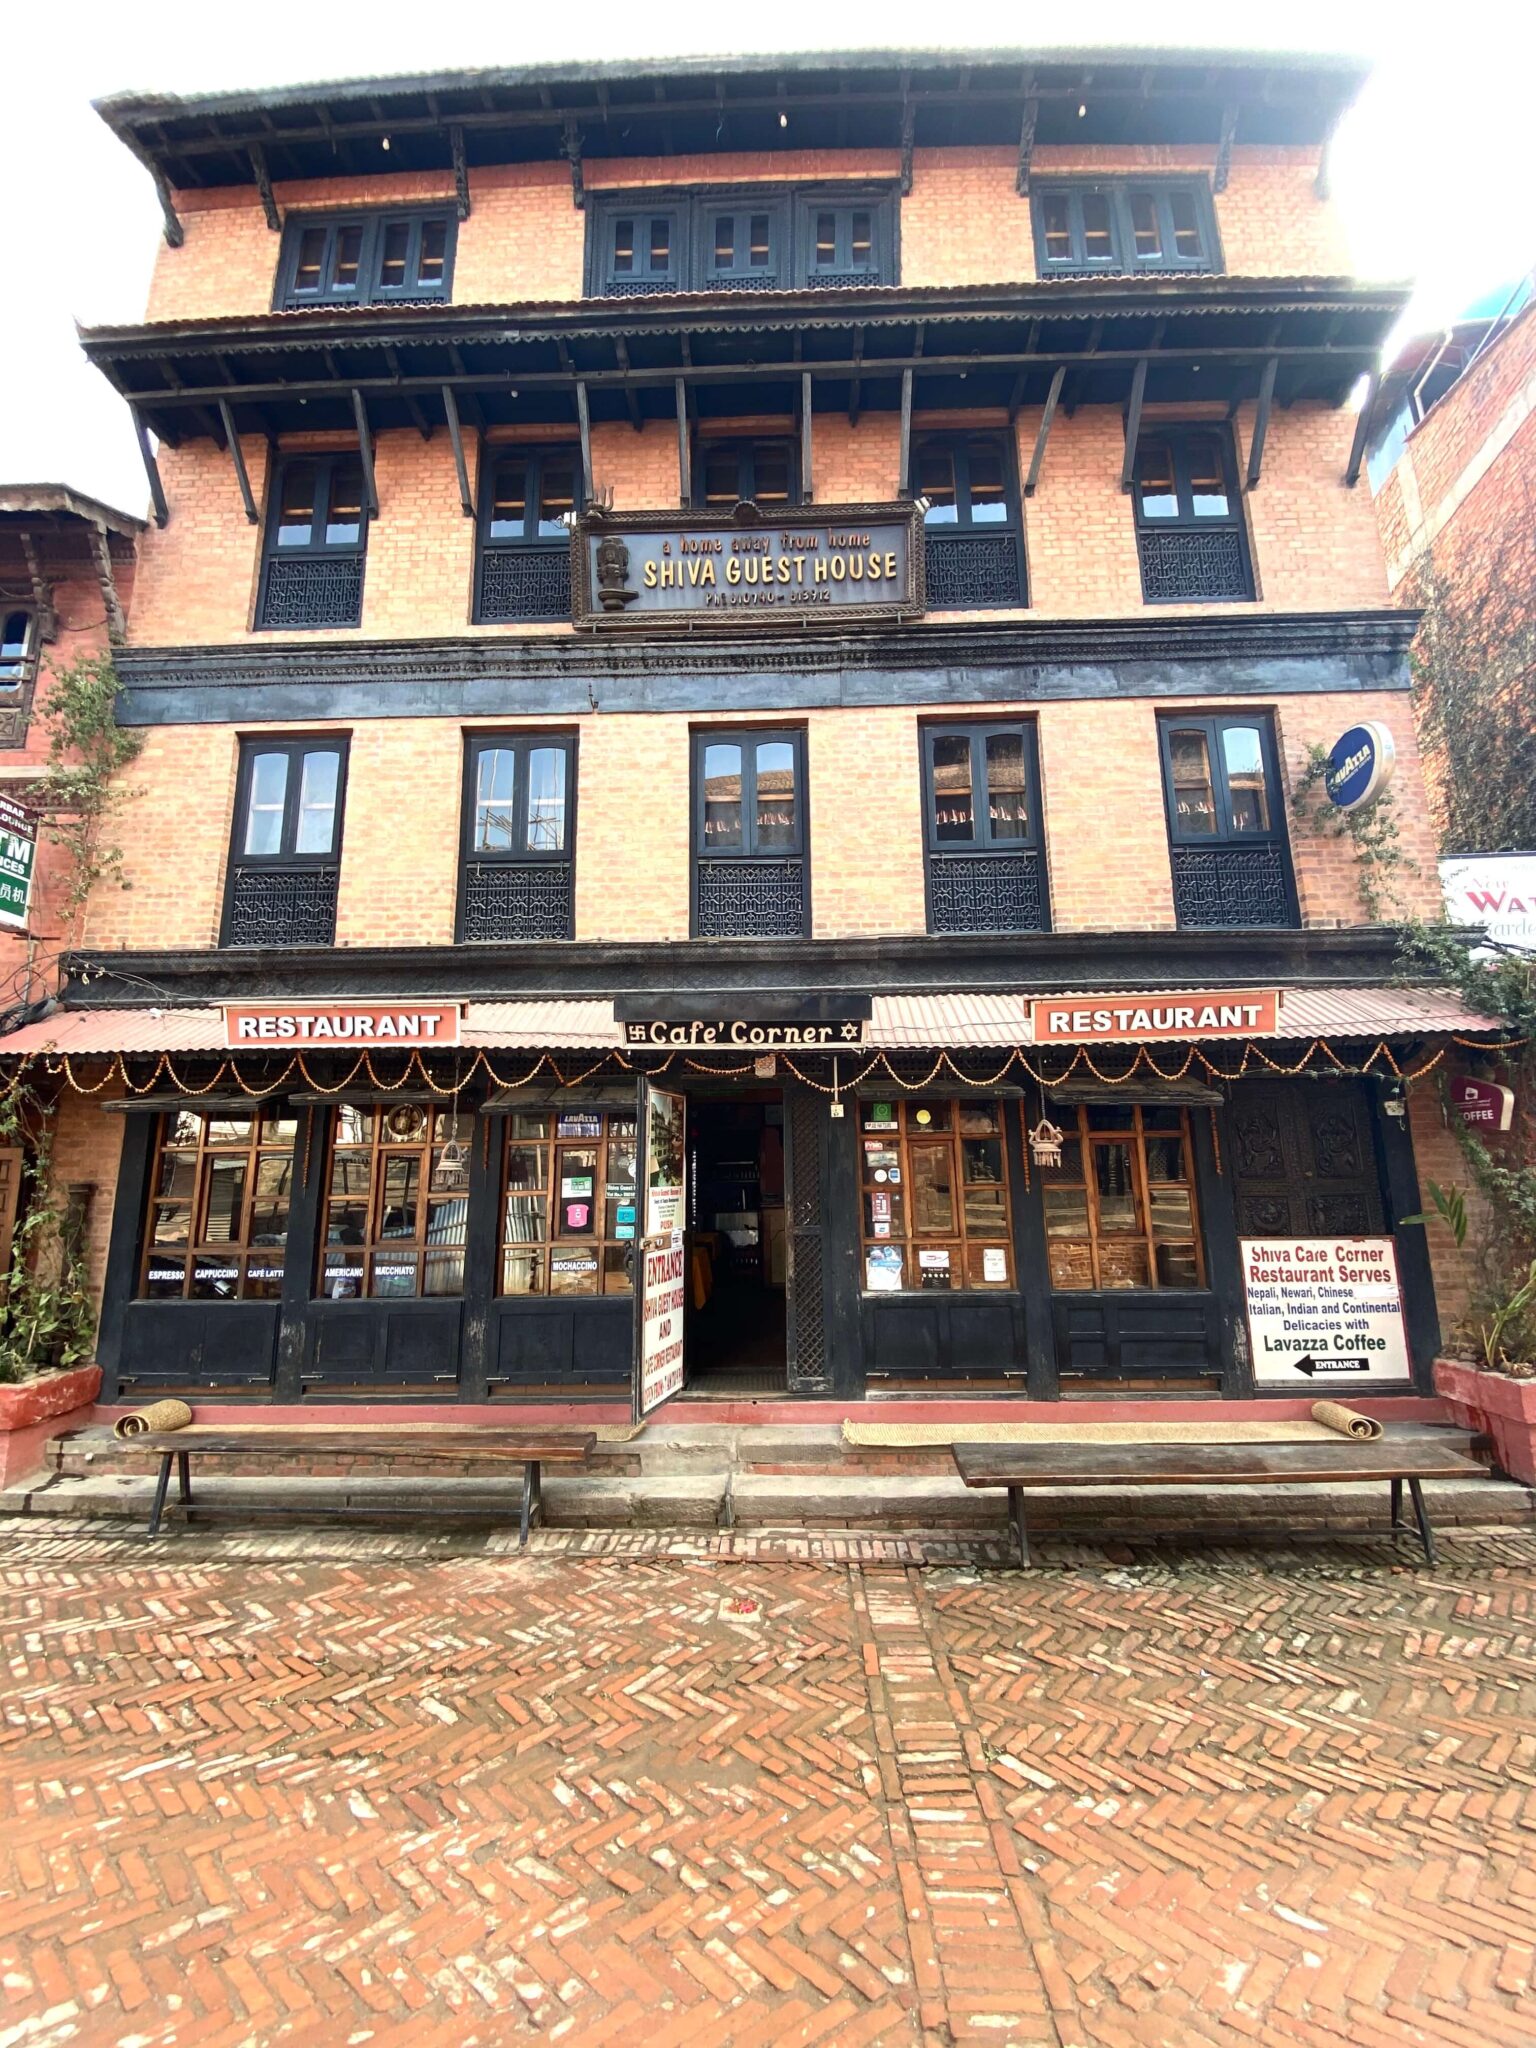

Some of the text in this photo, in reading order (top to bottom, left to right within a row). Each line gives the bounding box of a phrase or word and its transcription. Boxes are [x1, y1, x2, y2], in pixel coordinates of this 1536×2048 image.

[680, 535, 722, 555] home
[731, 536, 771, 558] away
[781, 531, 818, 552] from
[828, 527, 870, 549] home
[643, 551, 897, 588] SHIVA GUEST HOUSE
[238, 1015, 441, 1038] RESTAURANT
[1049, 1005, 1263, 1033] RESTAURANT
[731, 1020, 833, 1044] Corner
[1461, 1109, 1494, 1121] OFFEE
[1252, 1246, 1291, 1263] Shiva
[195, 1269, 239, 1279] CAPPUCCINO
[325, 1267, 364, 1277] AMERICANO
[552, 1261, 597, 1271] MOCHACCINO
[648, 1250, 682, 1288] ENTRANCE
[1250, 1265, 1391, 1283] Restaurant Serves
[148, 1270, 185, 1280] ESPRESSO
[1247, 1286, 1354, 1301] Nepali, Newari, Chinese
[1250, 1301, 1400, 1317] Italian, Indian and Continental
[659, 1318, 672, 1341] AND
[1283, 1319, 1369, 1331] Delicacies with
[1264, 1334, 1386, 1352] Lavazza Coffee
[1315, 1360, 1360, 1370] ENTRANCE
